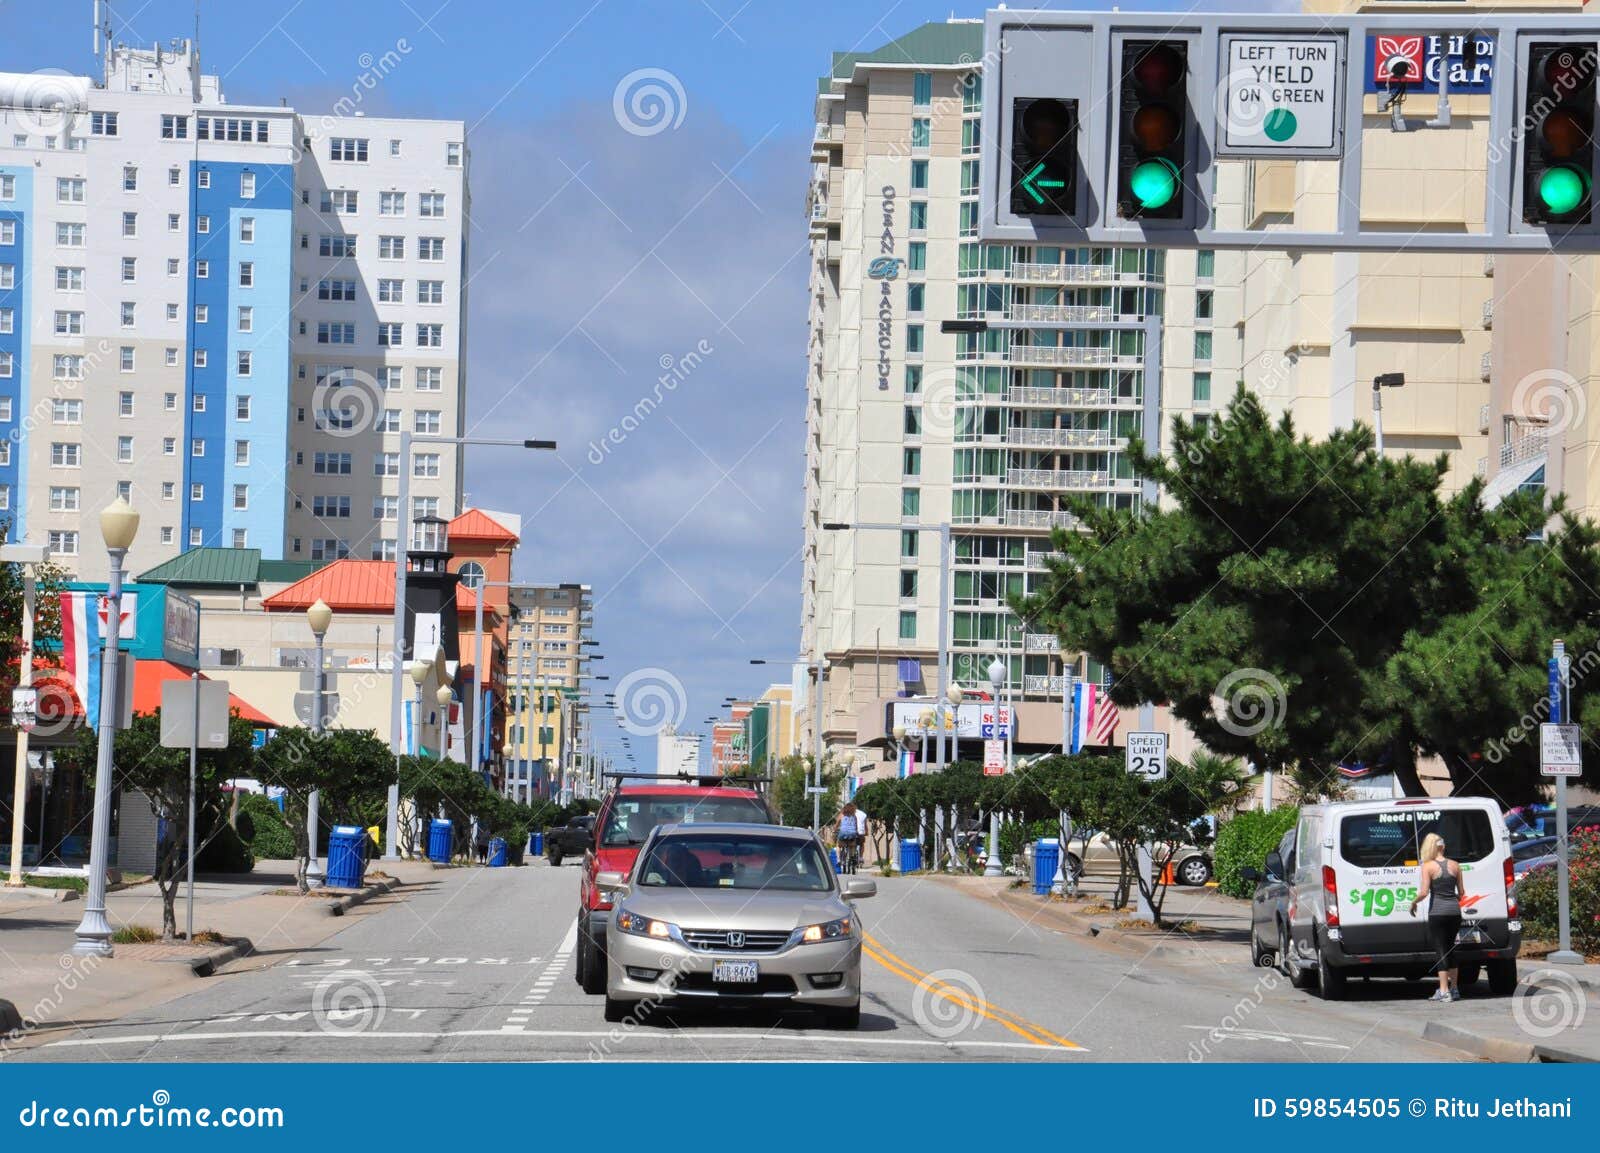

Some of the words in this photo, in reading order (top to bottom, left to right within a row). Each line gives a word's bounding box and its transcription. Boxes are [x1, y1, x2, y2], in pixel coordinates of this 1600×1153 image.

[1240, 47, 1275, 60] LEFT
[1288, 47, 1327, 61] TURN
[1252, 65, 1314, 83] YIELD
[1425, 56, 1494, 83] Gar
[1240, 88, 1261, 102] ON
[1272, 88, 1324, 103] GREEN
[880, 185, 896, 254] OCEAN
[1130, 737, 1163, 746] SPEED
[1132, 757, 1160, 775] 25
[1379, 812, 1406, 823] Need
[1416, 811, 1440, 821] Van?
